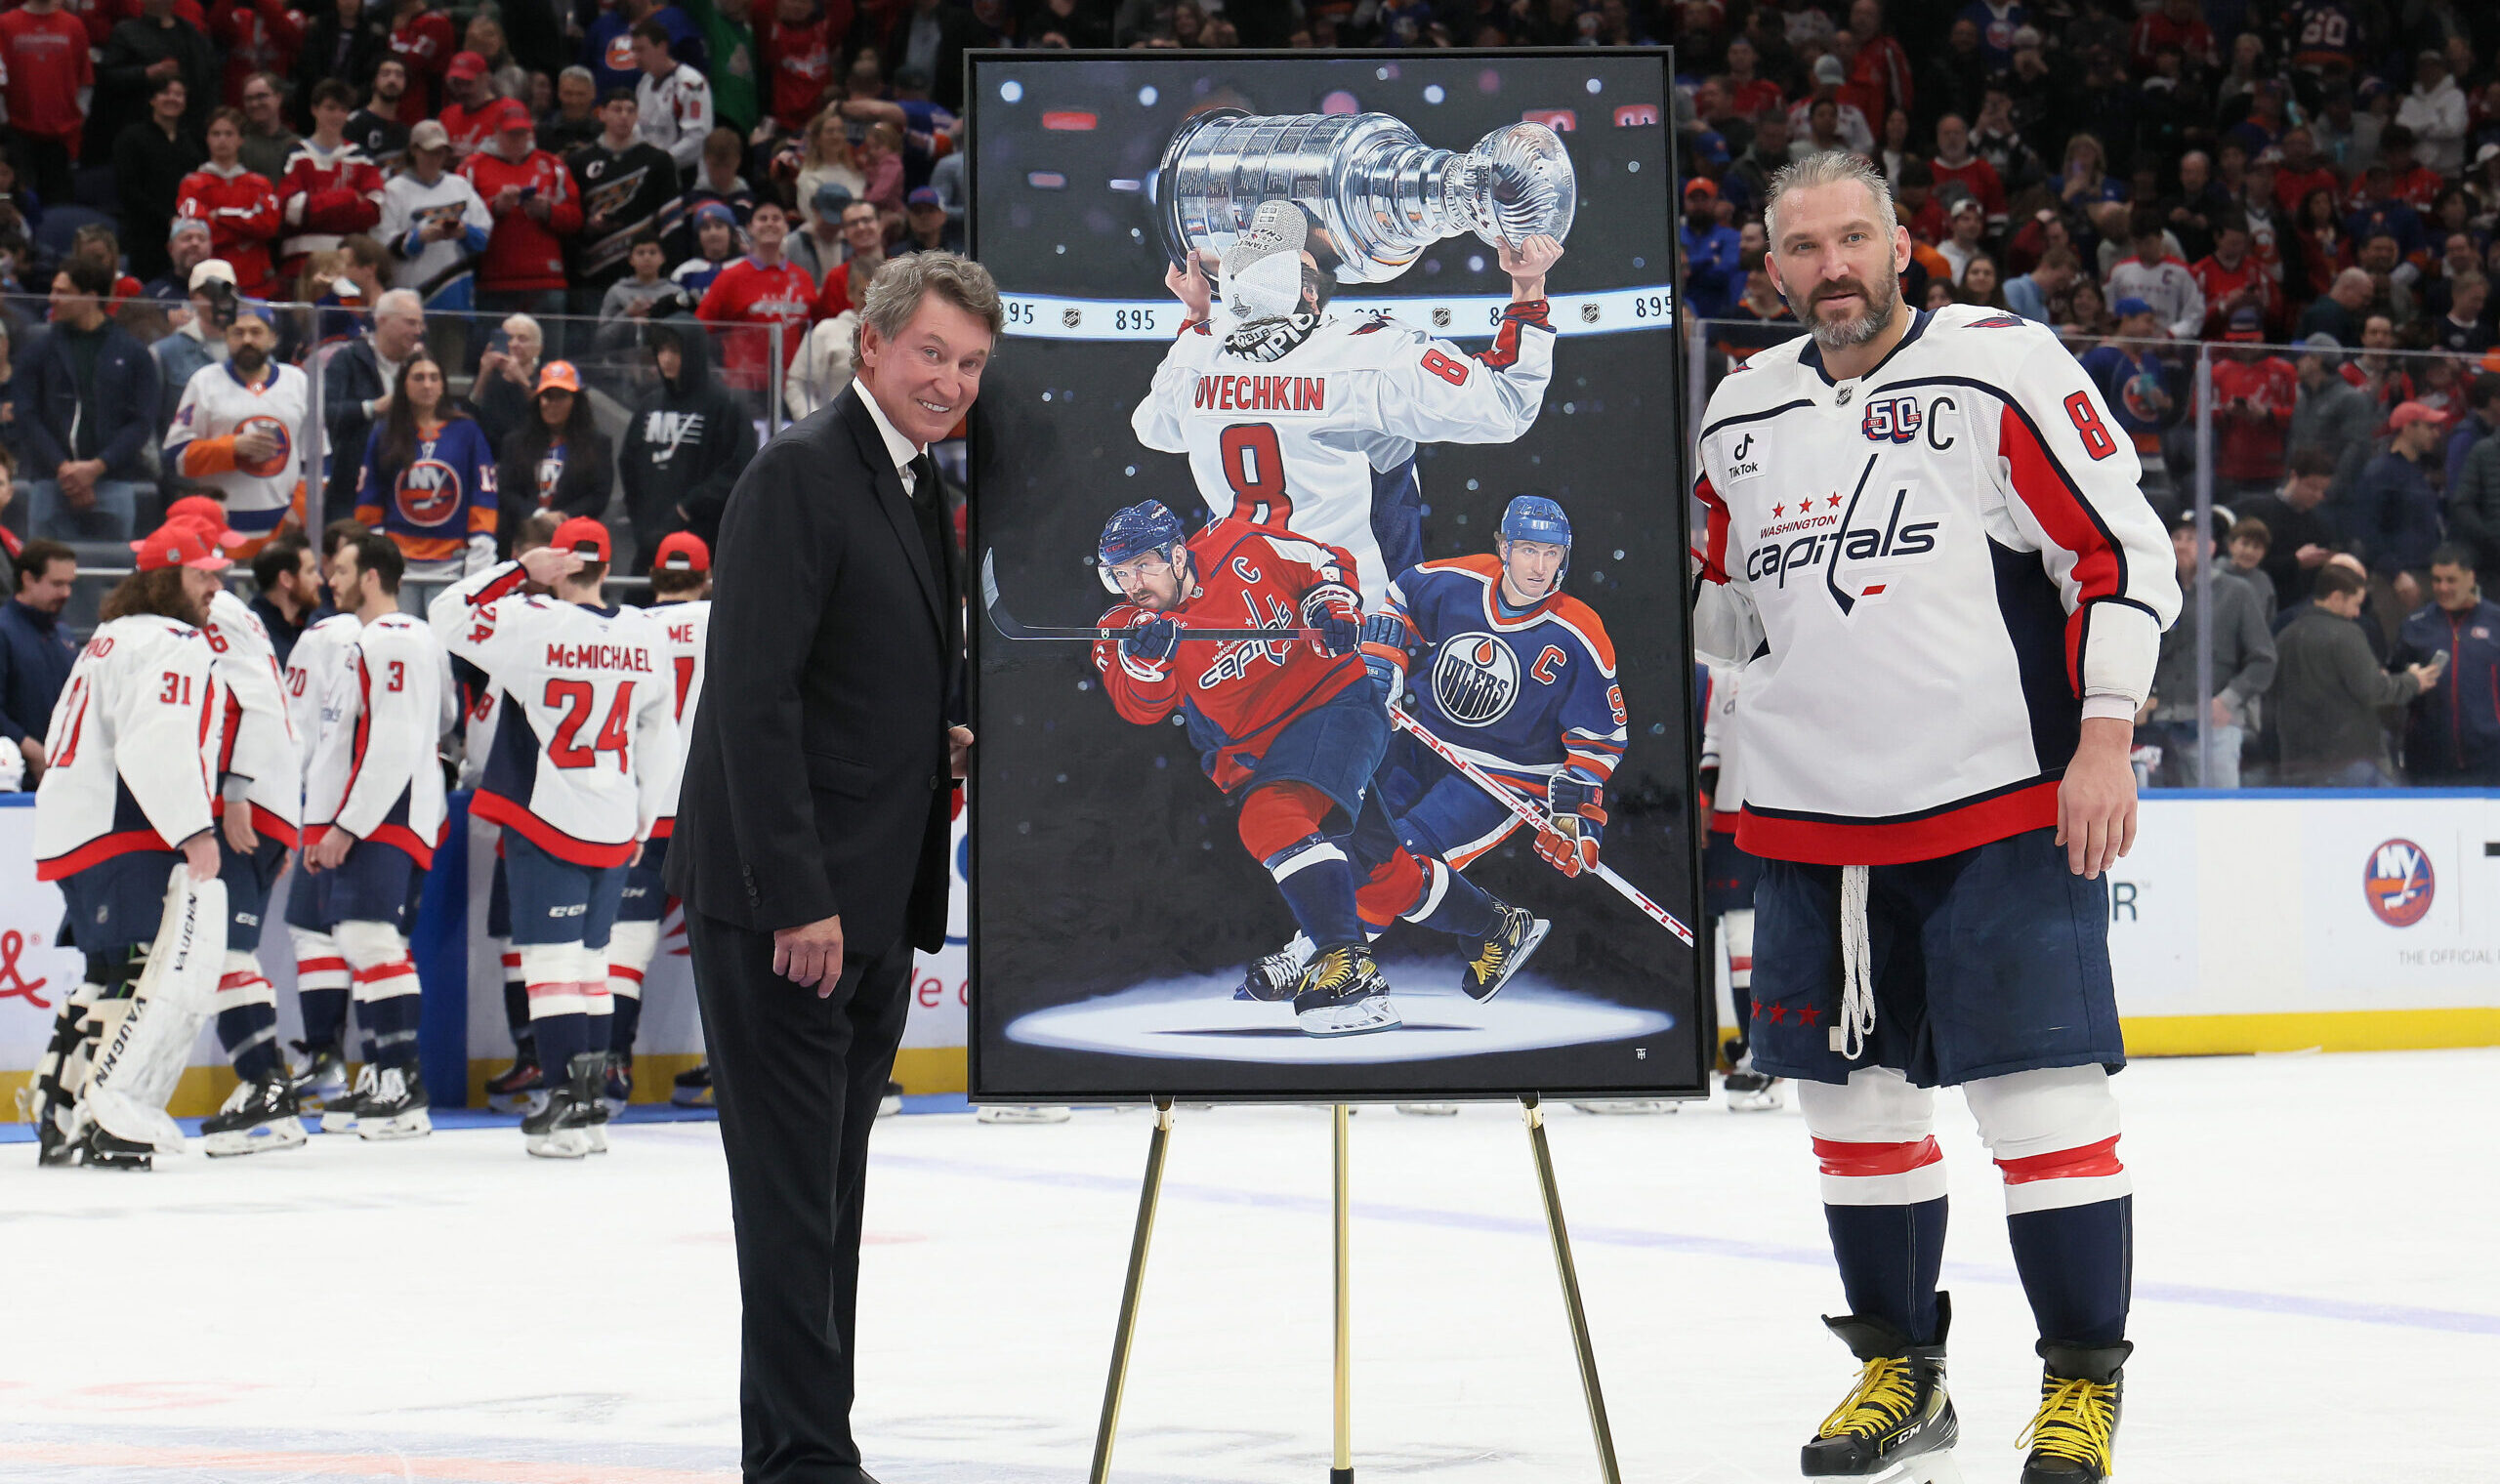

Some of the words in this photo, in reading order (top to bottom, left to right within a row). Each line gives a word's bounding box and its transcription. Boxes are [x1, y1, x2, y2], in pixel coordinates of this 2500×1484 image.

[1115, 309, 1155, 331] 895
[1421, 348, 1469, 387] 8
[1194, 375, 1325, 411] OVECHKIN
[1871, 400, 1918, 434] 50
[1927, 396, 1955, 450] C
[2063, 391, 2117, 461] 8
[1220, 422, 1294, 531] 8
[1729, 461, 1758, 478] TikTok
[1747, 455, 1938, 613] capitals
[1760, 515, 1838, 539] WASHINGTON
[1232, 556, 1262, 584] C
[668, 624, 694, 644] ME
[388, 661, 404, 692] 3
[547, 643, 653, 674] McMICHAEL
[1530, 644, 1567, 685] C
[160, 671, 191, 706] 31
[1440, 655, 1510, 718] OILERS
[543, 678, 638, 775] 24
[174, 892, 198, 972] VAUGHN
[2399, 950, 2425, 966] THE
[2429, 950, 2493, 966] OFFICIAL
[95, 996, 147, 1089] VAUGHN
